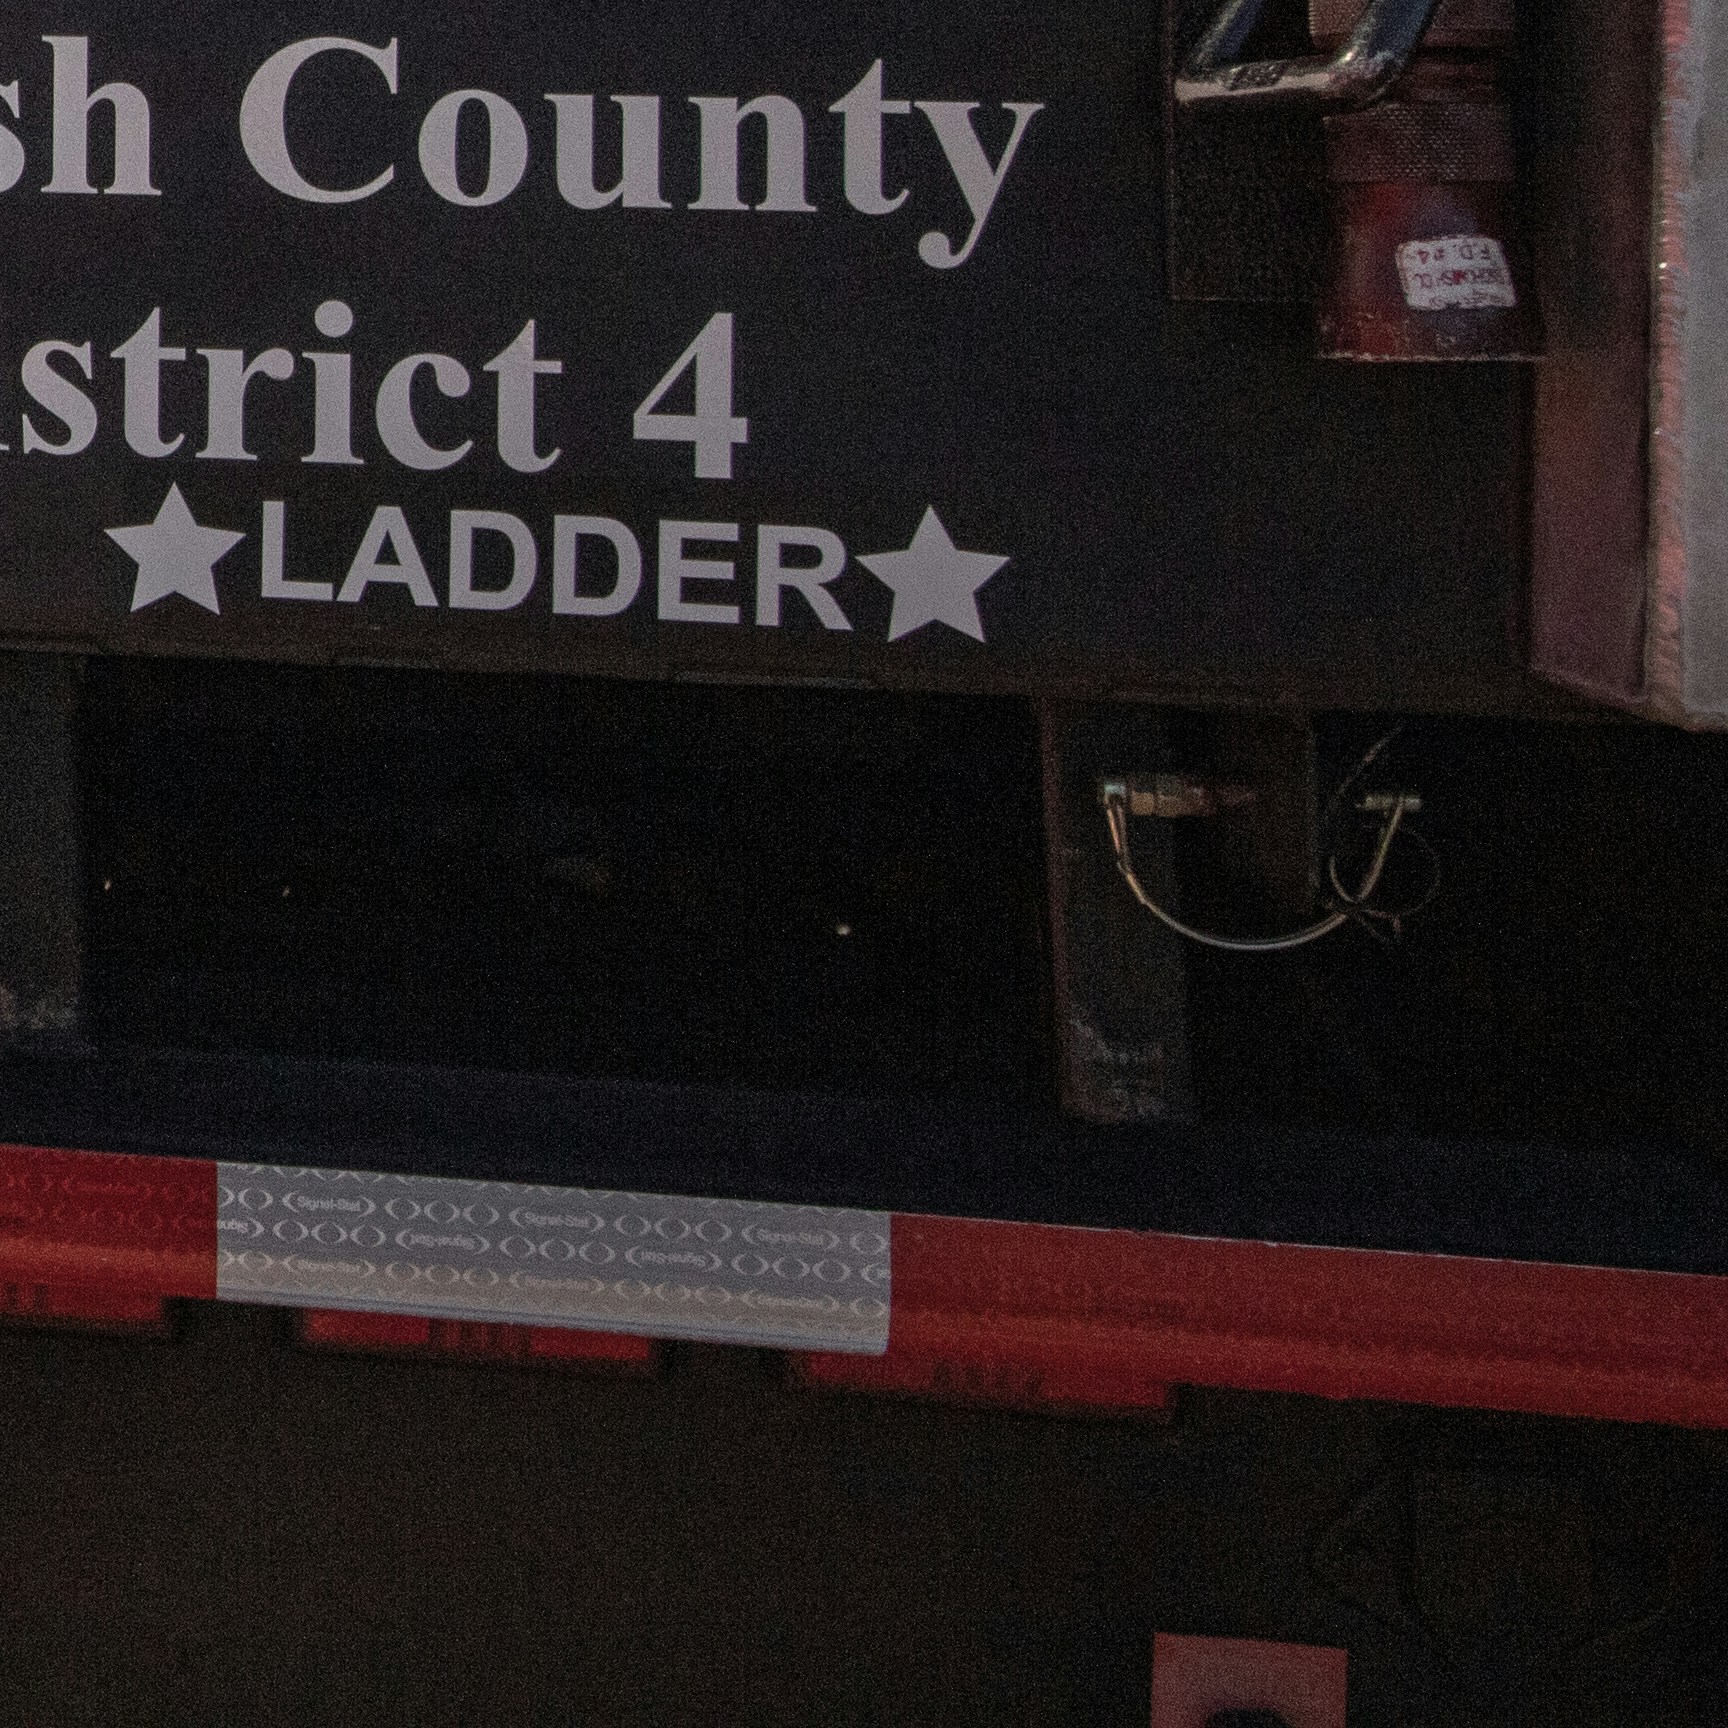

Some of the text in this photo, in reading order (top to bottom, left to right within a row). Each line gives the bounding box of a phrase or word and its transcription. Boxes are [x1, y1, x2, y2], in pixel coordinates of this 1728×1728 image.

[239, 36, 1044, 270] County
[633, 312, 748, 479] 4
[261, 500, 852, 632] LADDER
